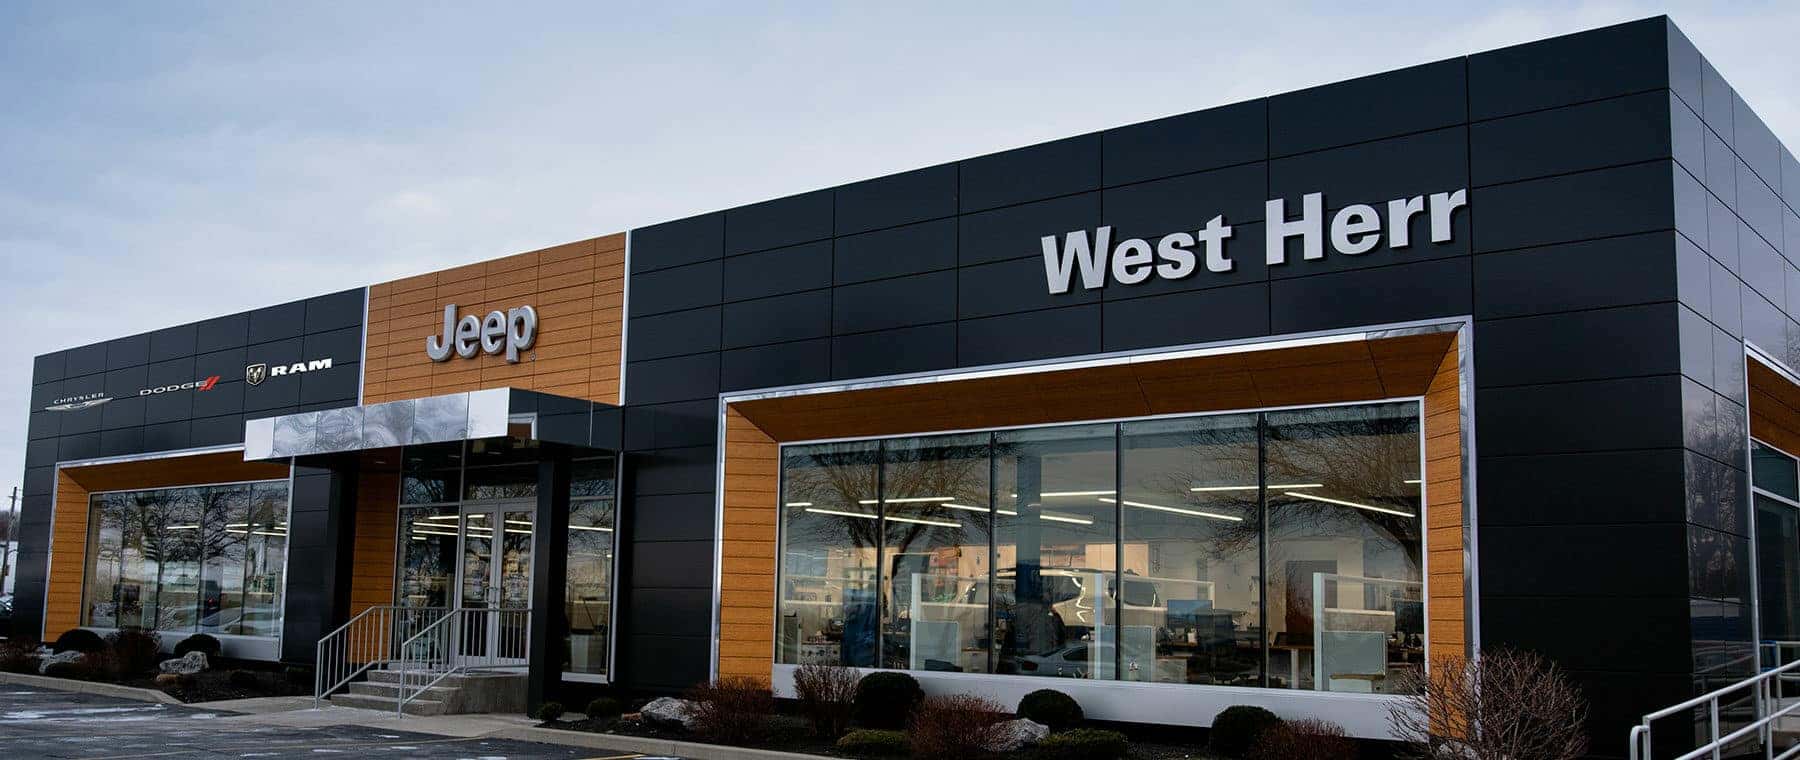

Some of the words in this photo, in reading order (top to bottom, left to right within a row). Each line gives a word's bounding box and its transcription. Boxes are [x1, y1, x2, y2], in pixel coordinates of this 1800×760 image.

[1041, 214, 1234, 294] West
[1265, 188, 1468, 265] Herr
[426, 303, 538, 363] Jeep
[271, 358, 333, 377] RAM
[139, 380, 208, 396] DODGE
[53, 392, 105, 405] CHRYSLER
